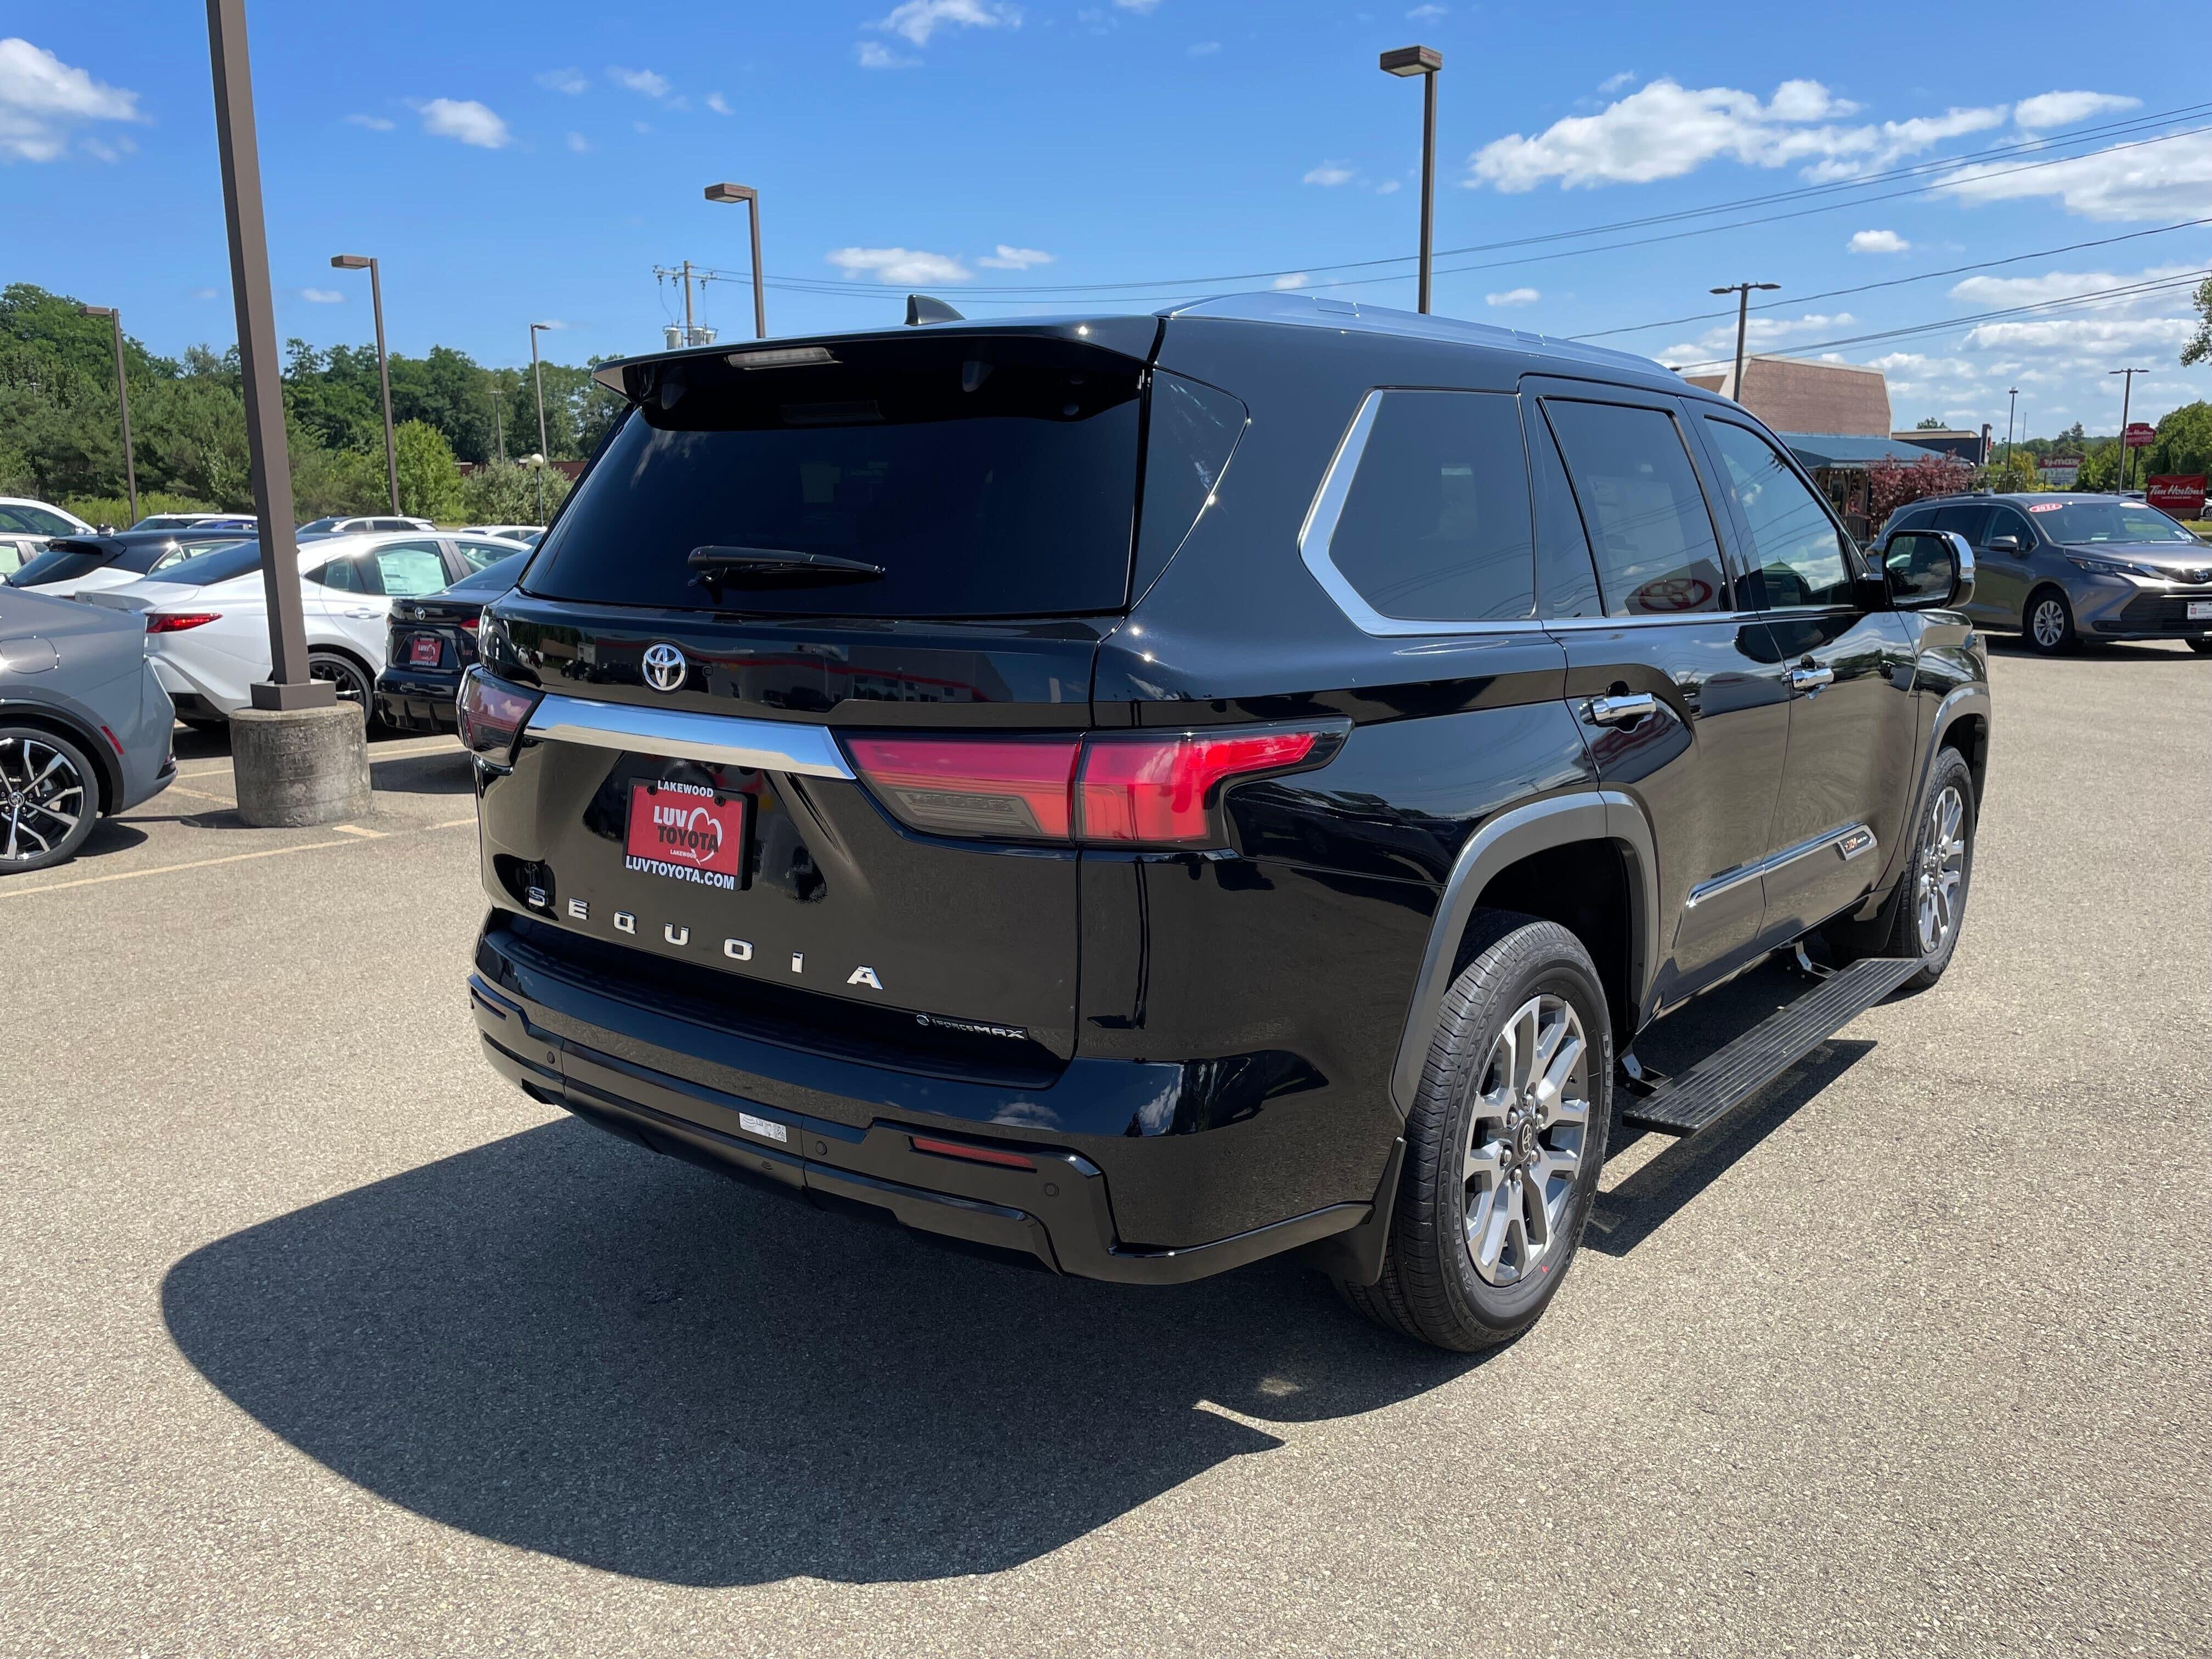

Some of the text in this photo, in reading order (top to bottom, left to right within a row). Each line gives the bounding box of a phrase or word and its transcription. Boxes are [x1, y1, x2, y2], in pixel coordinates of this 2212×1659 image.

[2149, 485, 2204, 495] Tim Hortons
[658, 780, 714, 798] LAKEWOOD
[654, 806, 687, 827] LUV
[658, 825, 718, 852] TOYOTA
[670, 849, 697, 859] LAKEWOOD
[625, 855, 735, 890] LUVTOYOTA.COM
[528, 885, 884, 990] SEQUOIA
